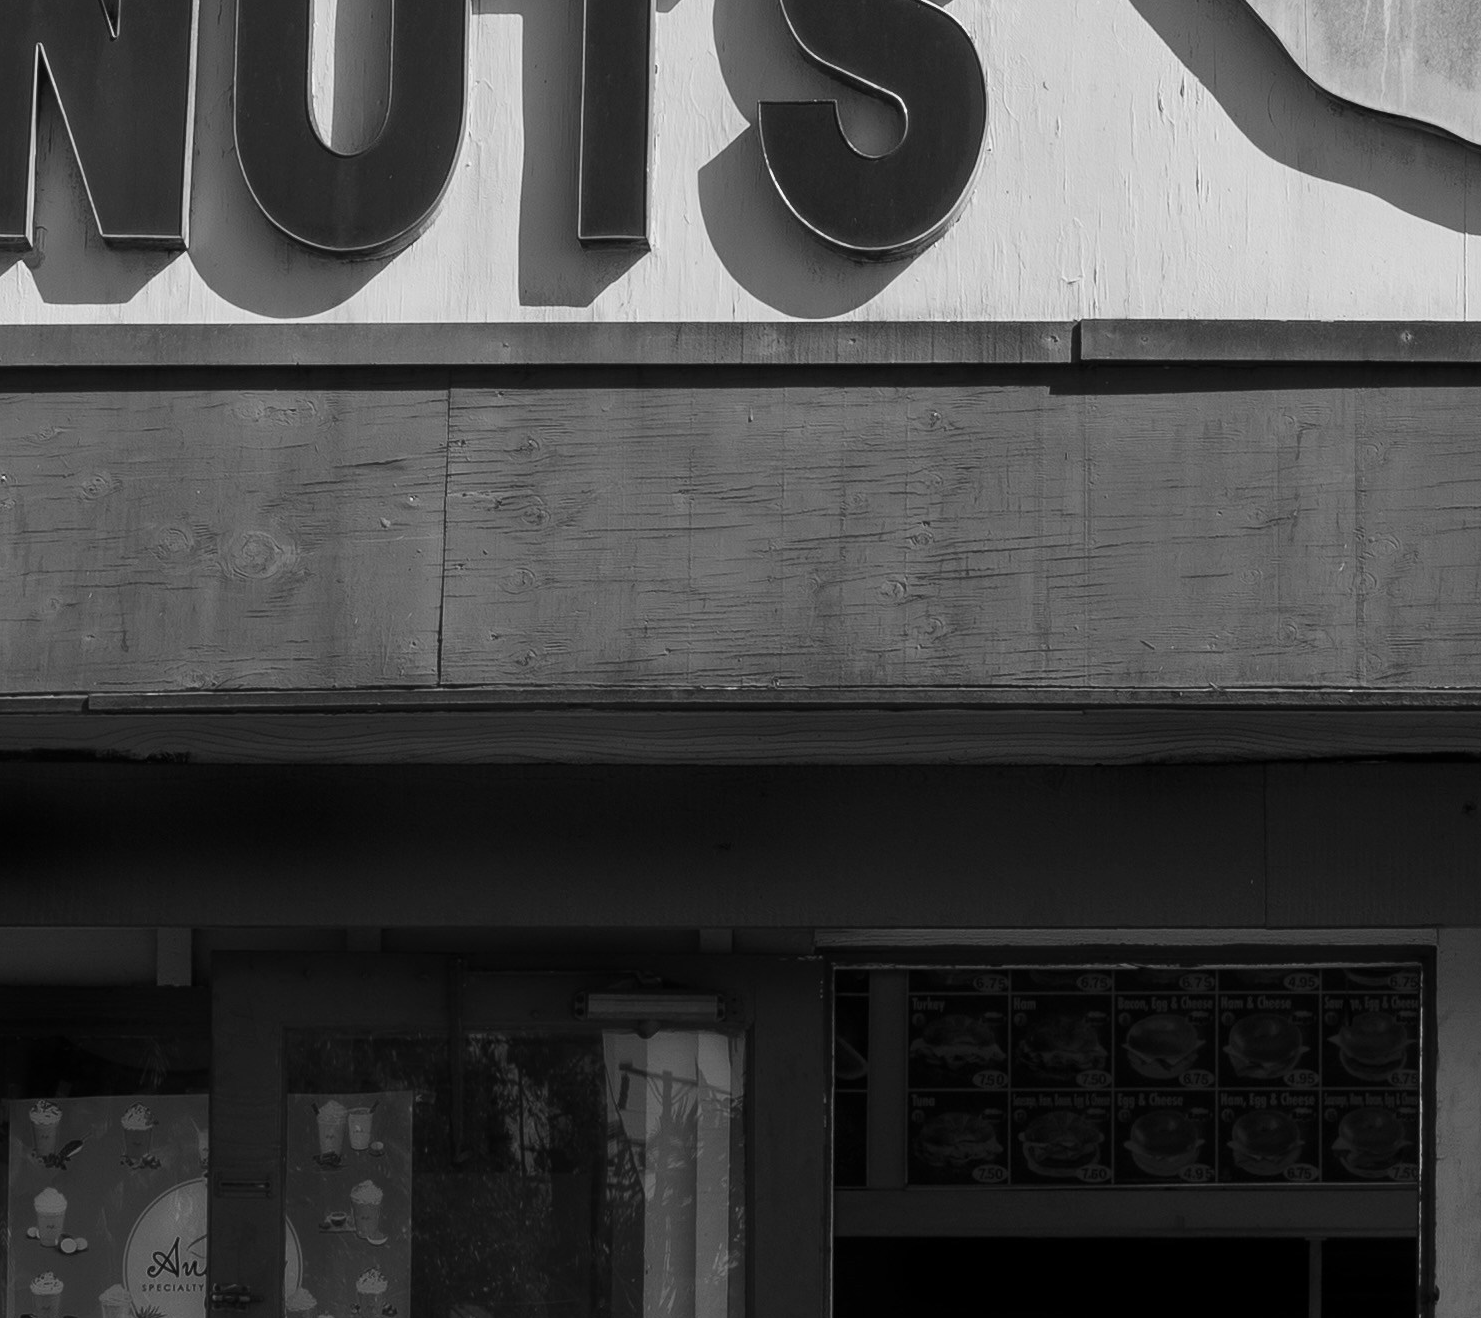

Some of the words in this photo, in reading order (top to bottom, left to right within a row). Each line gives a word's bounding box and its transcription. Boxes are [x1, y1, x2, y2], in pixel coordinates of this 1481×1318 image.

[911, 997, 945, 1012] Turkey
[1013, 996, 1037, 1010] Ham
[1117, 996, 1149, 1012] Bacon,
[1151, 996, 1168, 1012] Egg
[1180, 996, 1213, 1009] Cheese
[1221, 996, 1243, 1009] Ham
[1258, 995, 1291, 1009] Cheese
[911, 1093, 936, 1107] Tuna
[1117, 1093, 1136, 1109] Egg
[1149, 1092, 1184, 1106] Cheese
[1221, 1093, 1247, 1109] Ham,
[1249, 1093, 1267, 1109] Egg
[1280, 1092, 1315, 1106] Cheese
[141, 1283, 206, 1293] SPECIALTY
